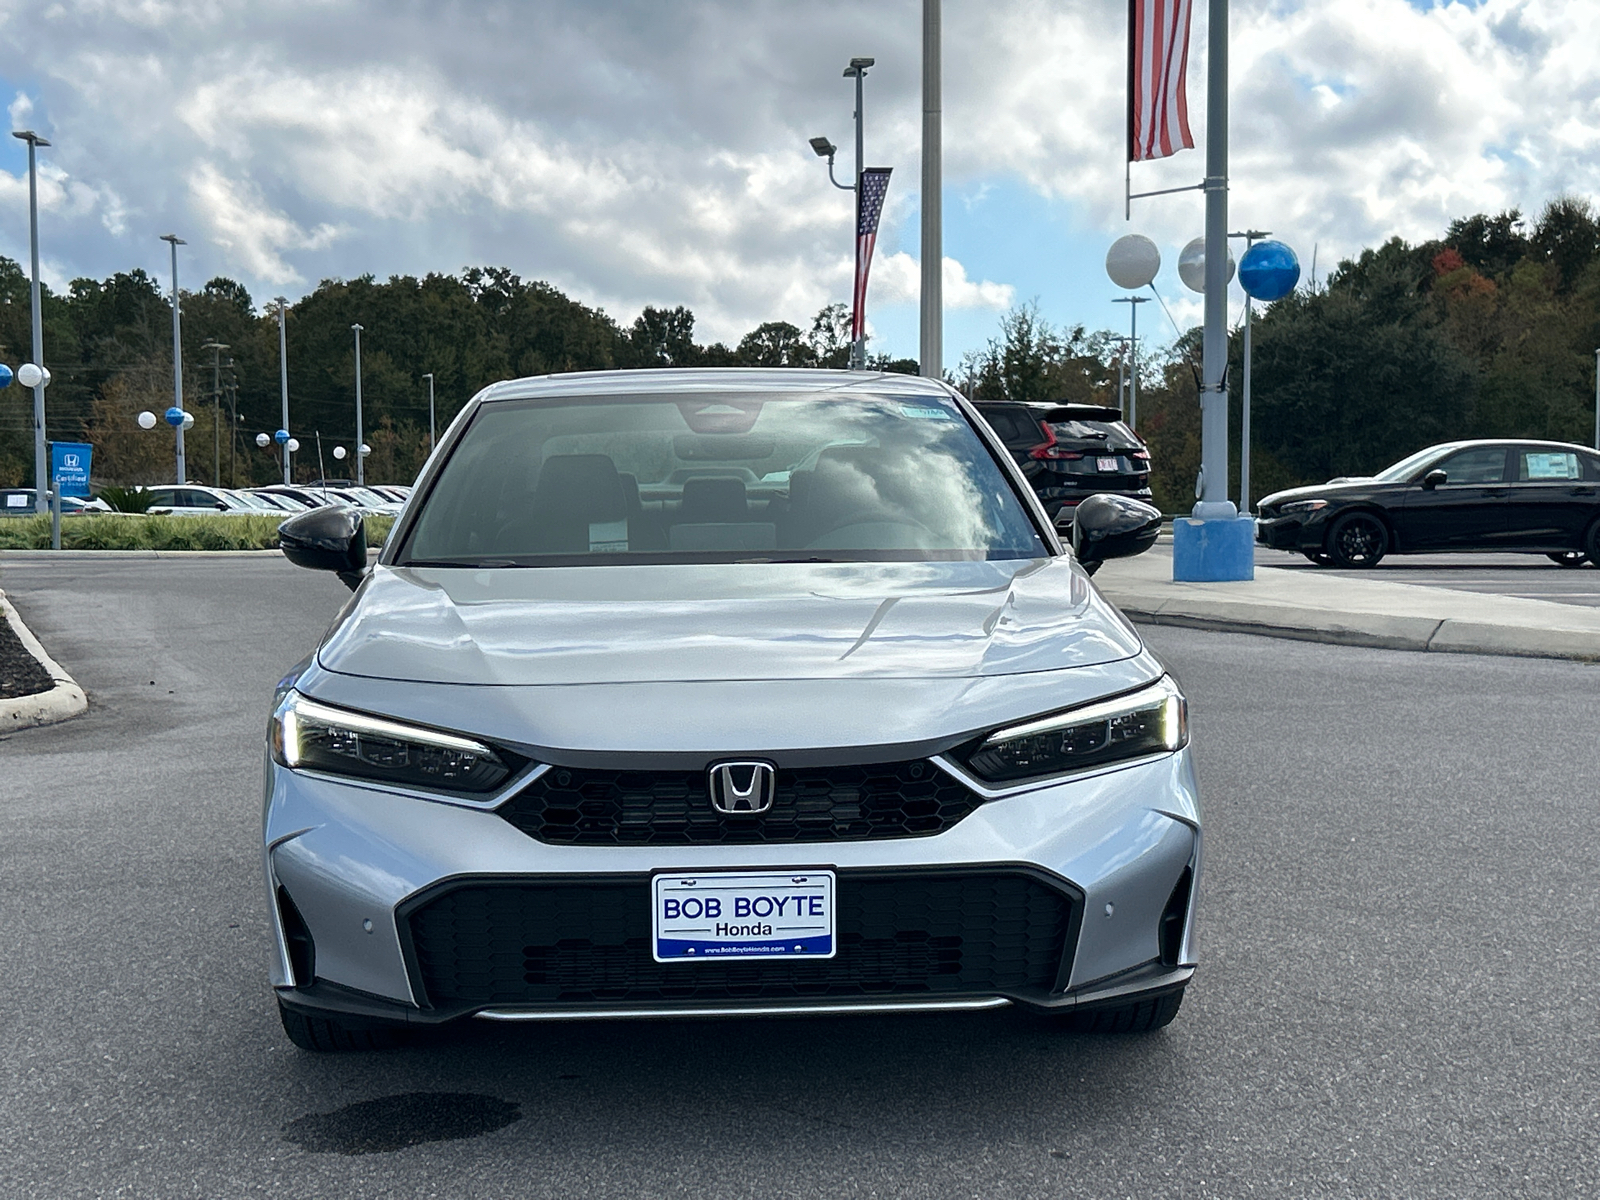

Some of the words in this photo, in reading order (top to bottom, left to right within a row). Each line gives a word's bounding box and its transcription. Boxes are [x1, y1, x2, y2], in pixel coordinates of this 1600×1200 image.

[664, 898, 722, 919] BOB
[734, 895, 825, 917] BOYTE
[715, 922, 773, 936] Honda
